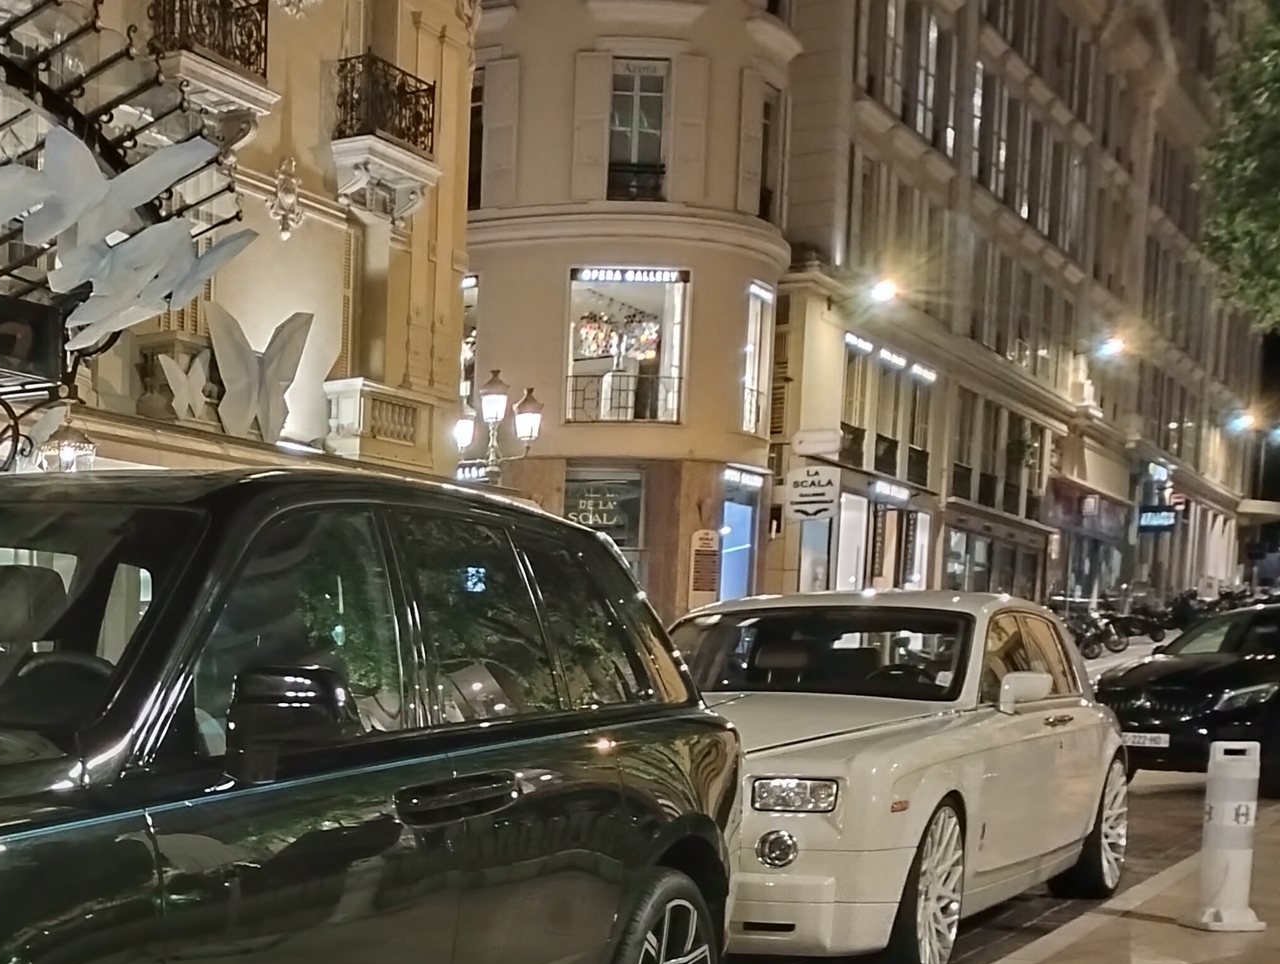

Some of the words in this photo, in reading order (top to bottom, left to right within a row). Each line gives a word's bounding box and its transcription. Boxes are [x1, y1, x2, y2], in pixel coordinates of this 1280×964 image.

[581, 269, 622, 281] OPERA
[625, 270, 678, 282] GALLERY
[793, 479, 833, 488] SCALA
[579, 500, 594, 510] DE
[599, 500, 614, 510] LA
